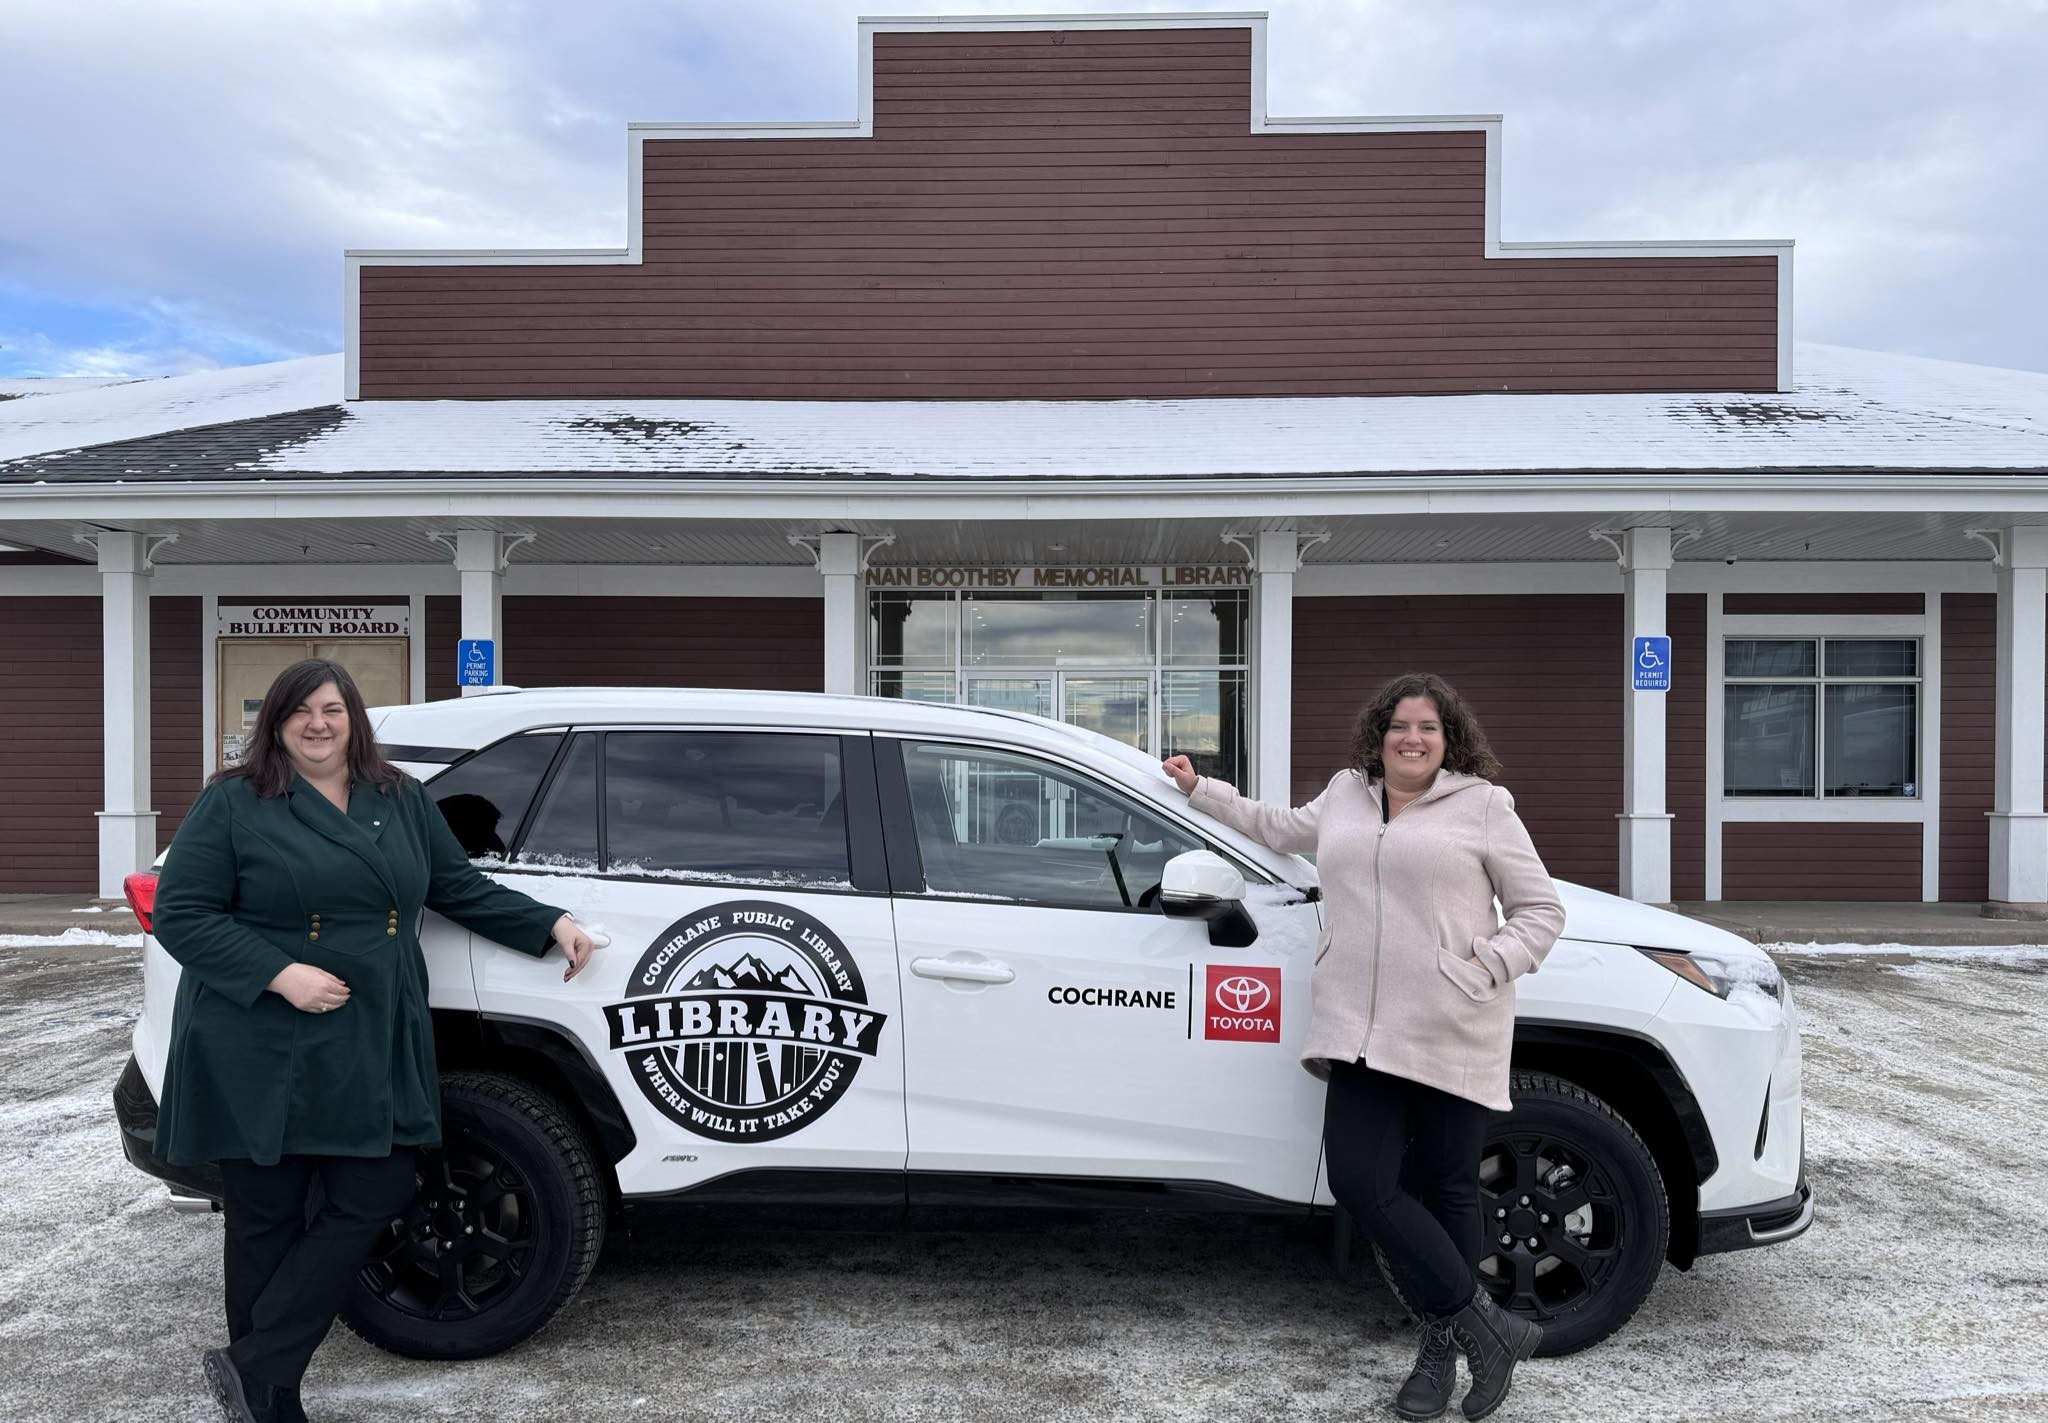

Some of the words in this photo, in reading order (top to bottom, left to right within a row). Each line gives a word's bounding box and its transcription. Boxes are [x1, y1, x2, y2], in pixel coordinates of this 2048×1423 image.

[866, 568, 912, 586] NAN
[917, 568, 1021, 587] BOOTHBY
[1033, 568, 1149, 587] MEMORIAL
[1162, 566, 1255, 586] LIBRARY
[252, 607, 374, 620] COMMUNITY
[229, 622, 323, 634] BULLETIN
[329, 622, 400, 634] BOARD
[466, 662, 487, 670] PERMIT
[1635, 679, 1667, 687] REQUIRED
[642, 915, 722, 986] COCHRANE
[732, 911, 795, 932] PUBLIC
[800, 927, 854, 993] LIBRARY
[1047, 986, 1176, 1009] COCHRANE
[618, 999, 874, 1048] LIBRARY
[1210, 1016, 1275, 1032] TOYOTA
[642, 1054, 690, 1115] WHERE
[691, 1109, 736, 1133] WILL
[739, 1118, 759, 1133] IT
[764, 1096, 814, 1130] TAKE
[816, 1057, 846, 1101] YOU?
[661, 1154, 699, 1162] AWD
